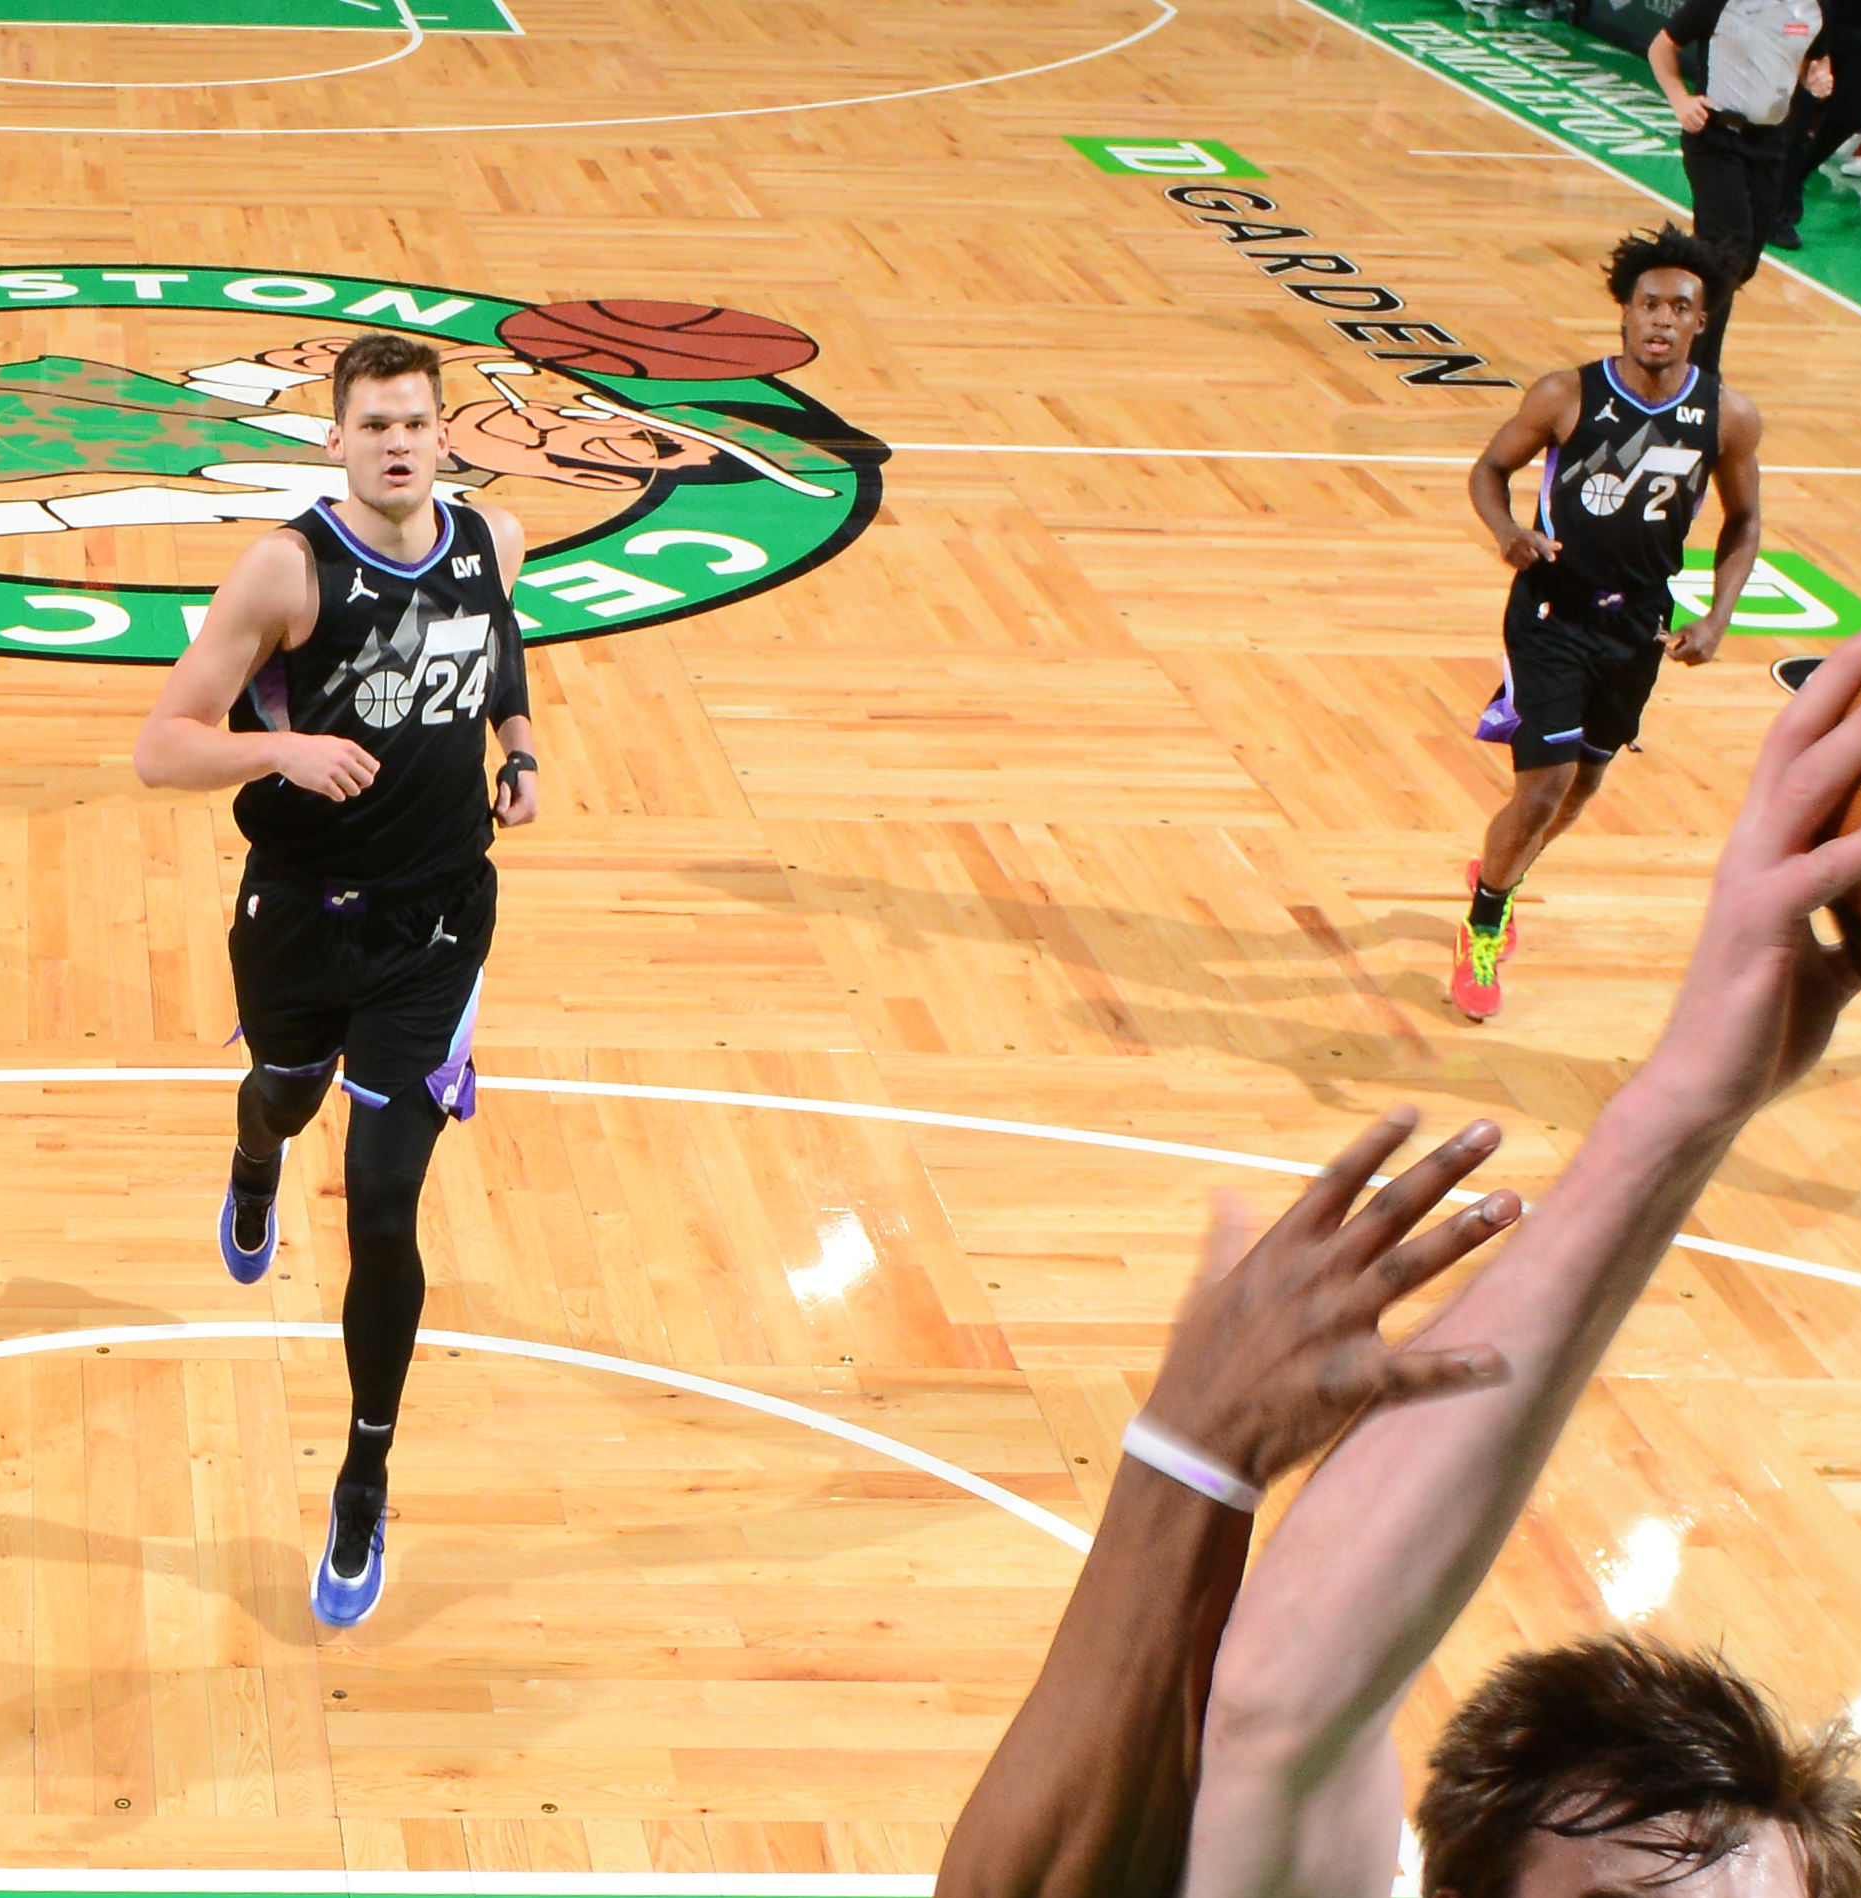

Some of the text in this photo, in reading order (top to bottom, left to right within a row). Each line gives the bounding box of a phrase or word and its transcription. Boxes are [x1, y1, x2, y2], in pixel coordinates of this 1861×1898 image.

[1372, 20, 1684, 157] TEMPLETON
[1465, 28, 1684, 138] FRANKLI
[1103, 140, 1227, 175] TD
[1162, 184, 1525, 390] GARDEN
[1675, 404, 1706, 426] LVT
[1642, 475, 1678, 522] 2
[450, 554, 482, 580] LVT
[421, 655, 489, 726] 24
